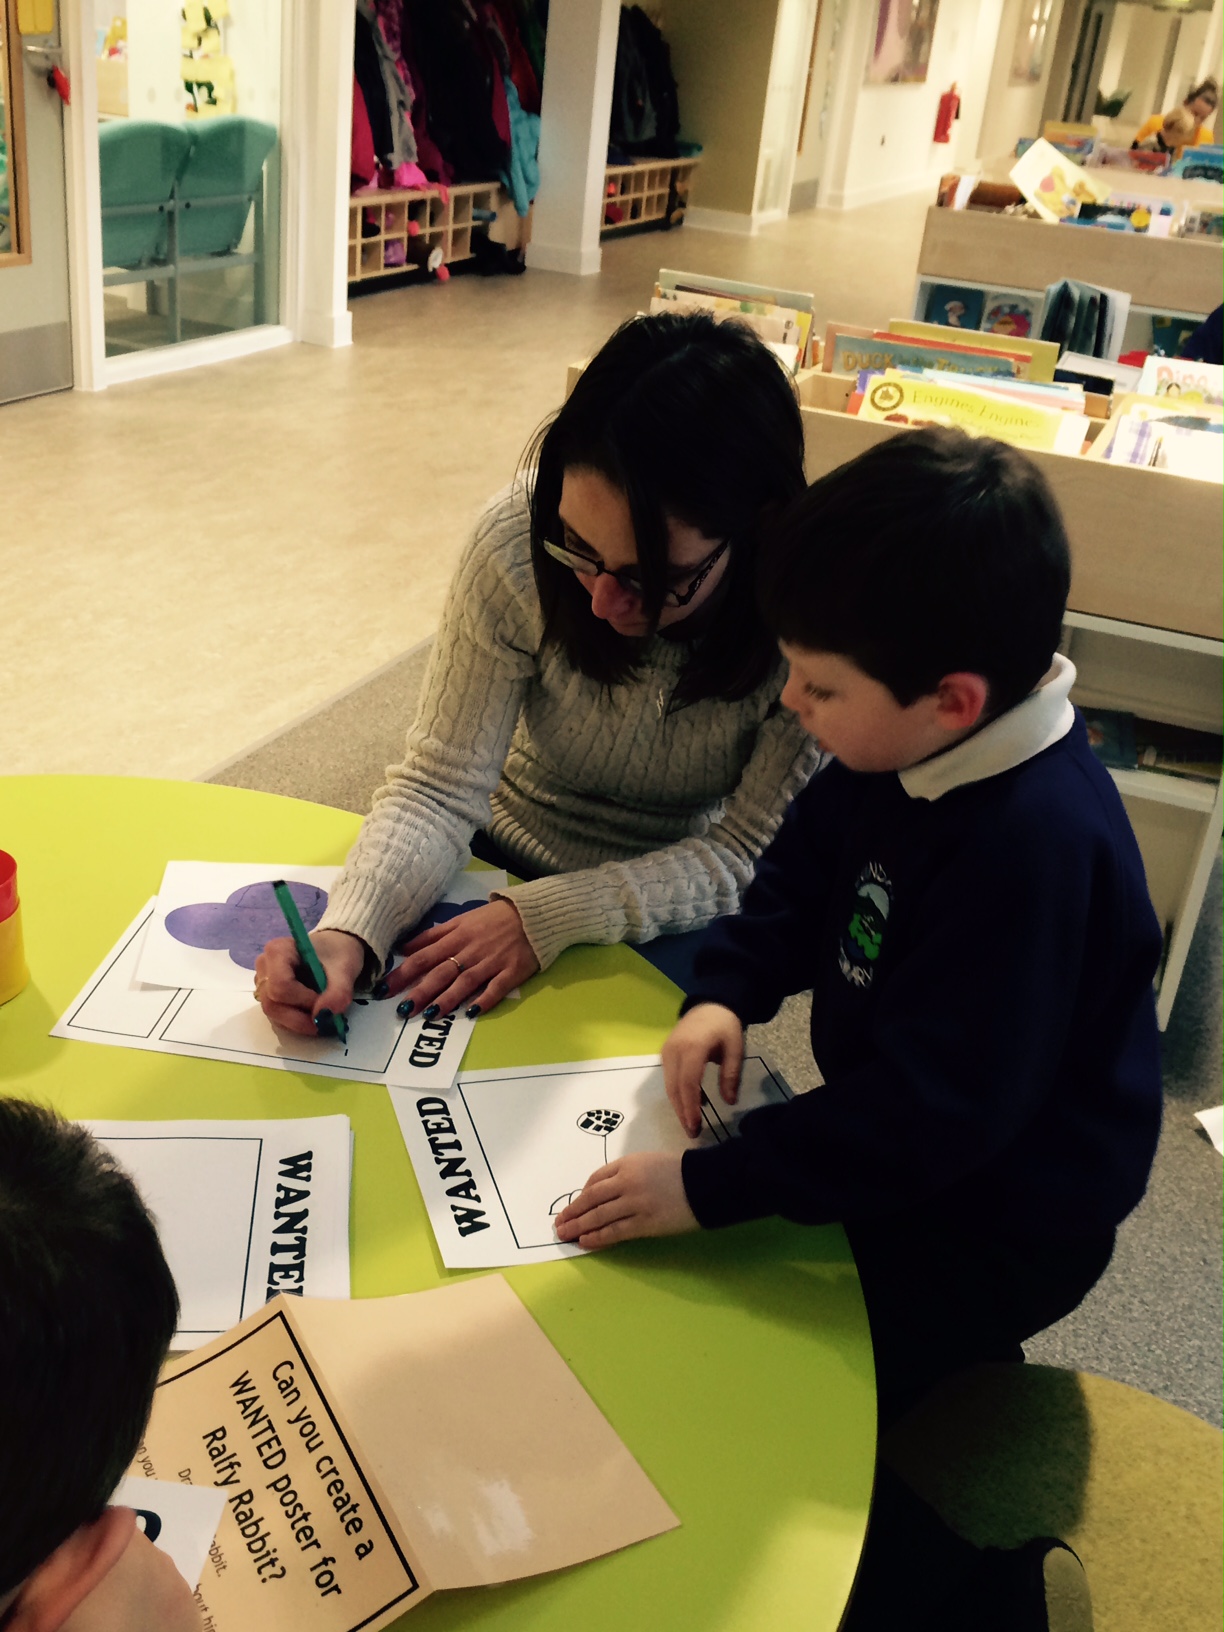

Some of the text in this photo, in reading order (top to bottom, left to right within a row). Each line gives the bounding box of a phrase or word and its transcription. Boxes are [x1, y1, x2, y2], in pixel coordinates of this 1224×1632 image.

[841, 350, 895, 372] DUCK
[912, 389, 974, 413] Engines
[408, 1012, 456, 1068] TED
[265, 1150, 313, 1298] WANTE
[416, 1096, 491, 1237] WANTED
[202, 1425, 287, 1585] Ralfy Rabbit?
[229, 1370, 342, 1598] WANTED poster for
[271, 1360, 375, 1560] Can you create a
[208, 1534, 228, 1577] abbit.
